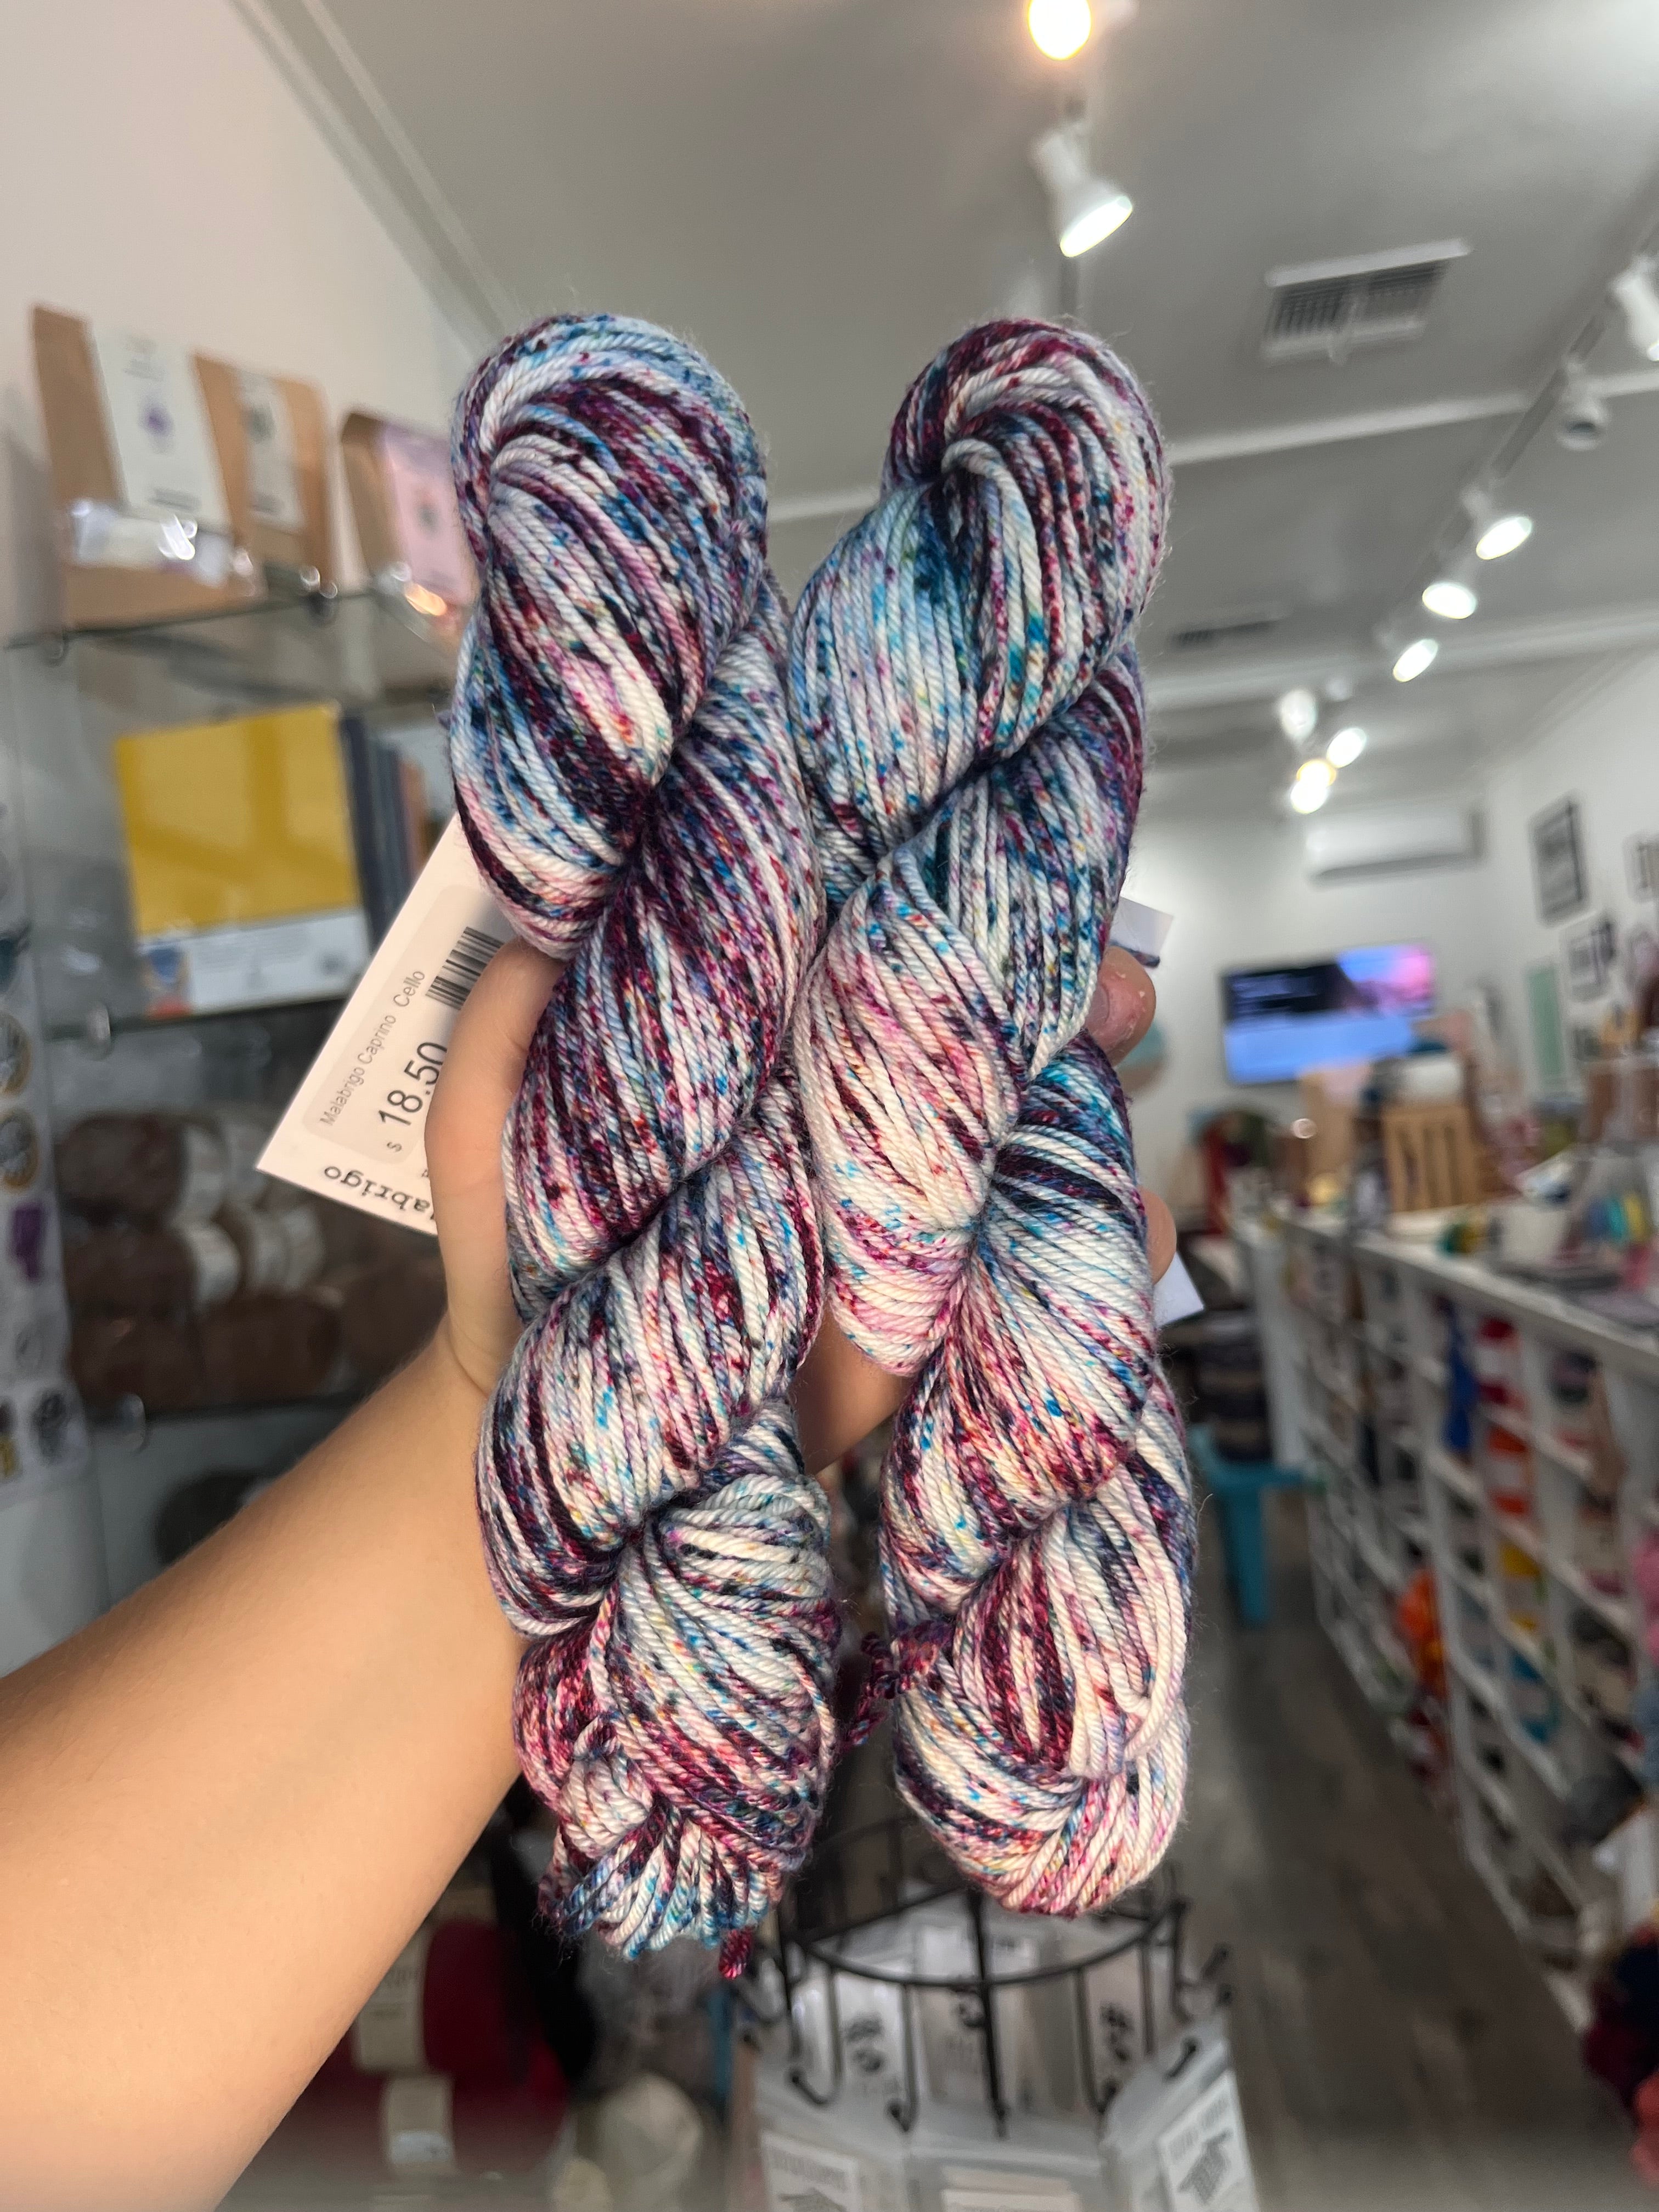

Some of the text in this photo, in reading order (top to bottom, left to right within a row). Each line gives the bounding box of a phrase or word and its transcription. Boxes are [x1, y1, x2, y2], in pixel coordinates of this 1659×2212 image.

[319, 971, 425, 1125] Malabrigo Caprino Cello
[379, 1042, 447, 1125] 18.50
[324, 1166, 435, 1220] abrigo
